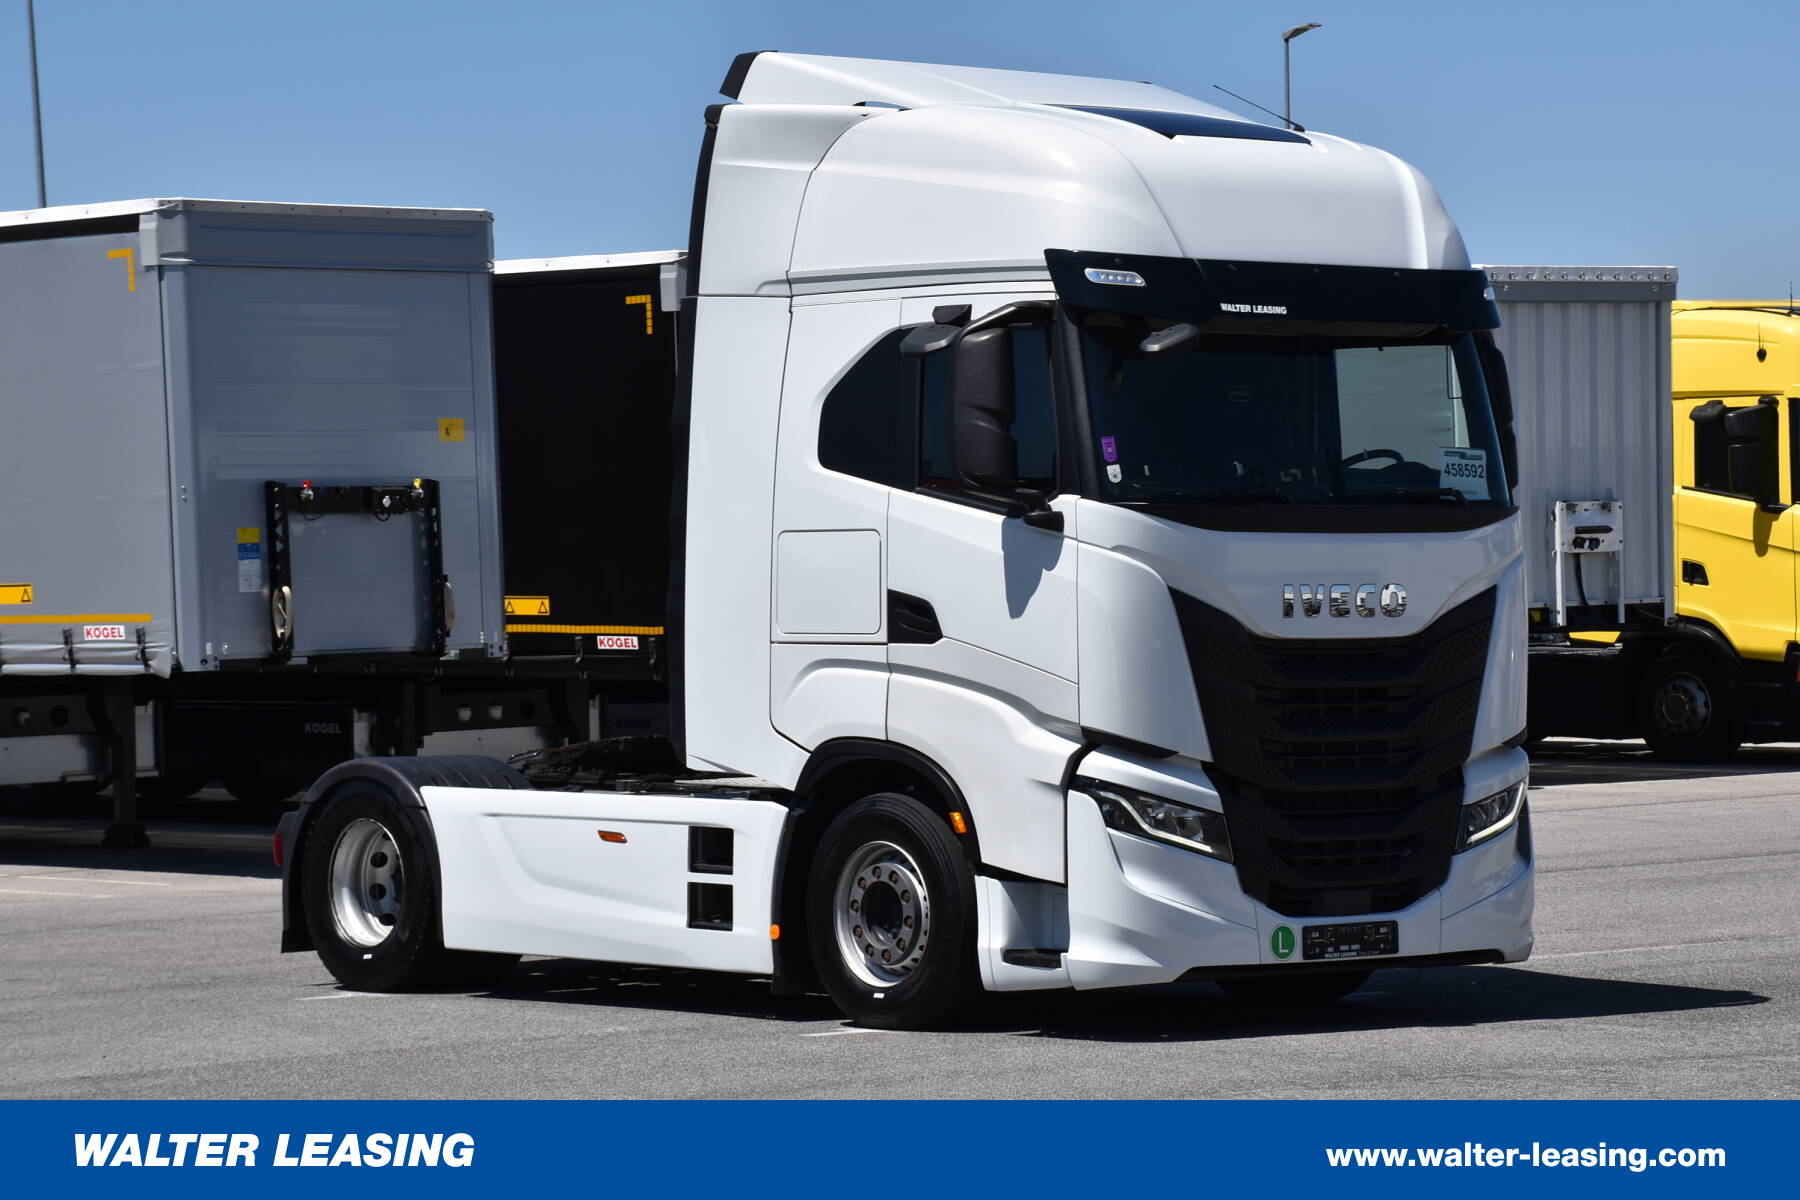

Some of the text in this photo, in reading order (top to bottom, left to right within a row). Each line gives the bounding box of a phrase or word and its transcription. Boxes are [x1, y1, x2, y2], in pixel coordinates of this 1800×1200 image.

[1219, 303, 1287, 315] WALTER LEASING
[1444, 462, 1485, 479] 458592
[1282, 583, 1408, 618] IVECO
[1278, 931, 1289, 953] L
